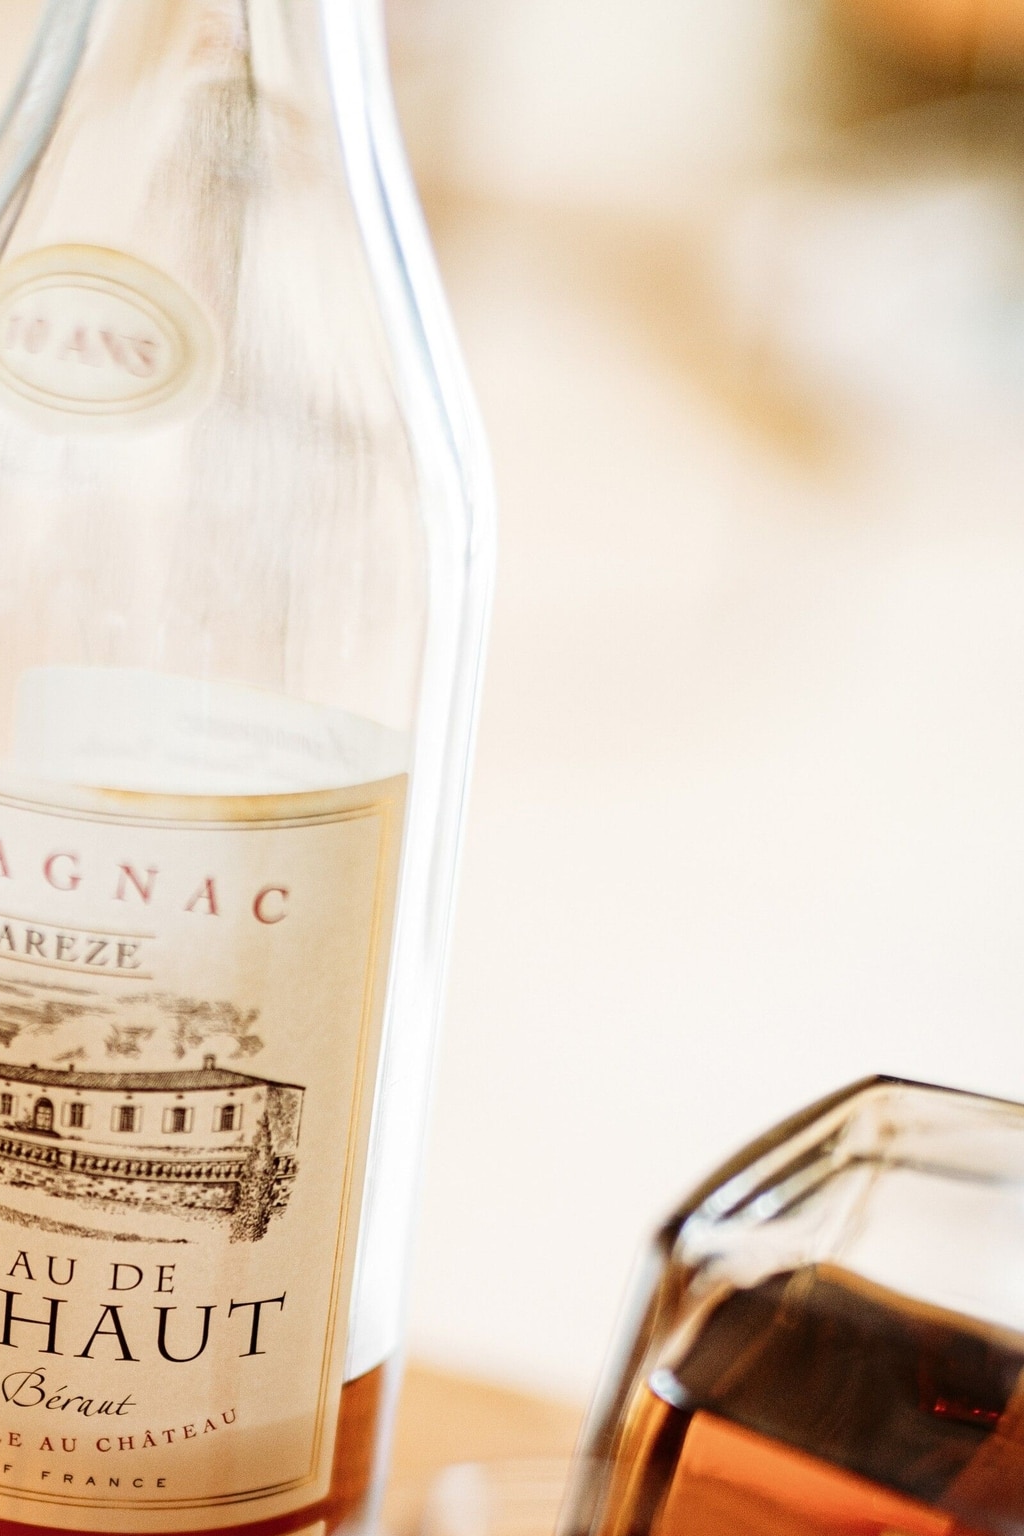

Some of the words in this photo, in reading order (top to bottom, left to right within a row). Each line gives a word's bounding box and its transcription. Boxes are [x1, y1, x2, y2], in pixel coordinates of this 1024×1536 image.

[108, 1262, 178, 1294] DE
[1, 1366, 138, 1418] Béraut
[39, 1435, 78, 1453] AU
[96, 1408, 239, 1453] CHÂTEAU
[40, 1470, 168, 1489] FRANCE
